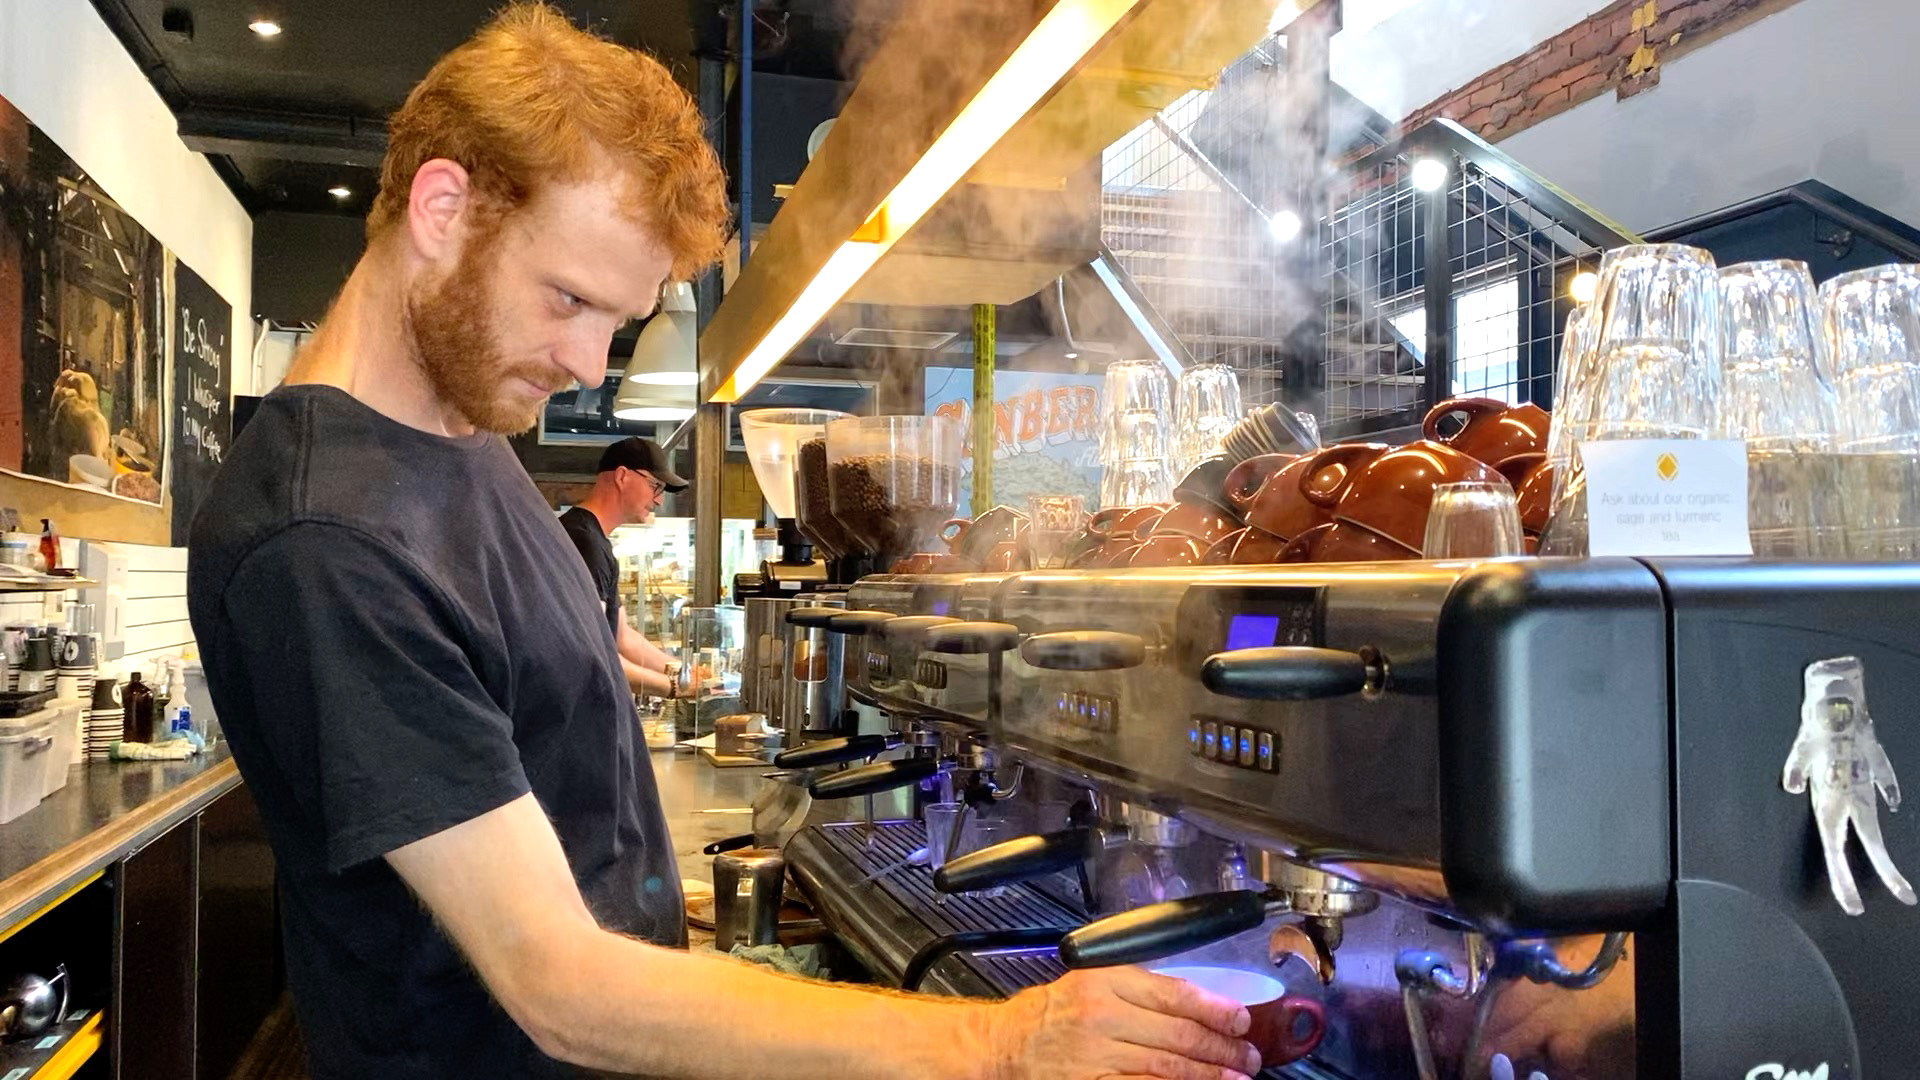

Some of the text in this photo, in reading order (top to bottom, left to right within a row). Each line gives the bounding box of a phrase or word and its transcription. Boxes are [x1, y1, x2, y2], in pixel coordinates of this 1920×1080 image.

[935, 385, 1099, 458] NBER
[1602, 491, 1730, 506] Ask about our organic
[1649, 510, 1671, 524] and
